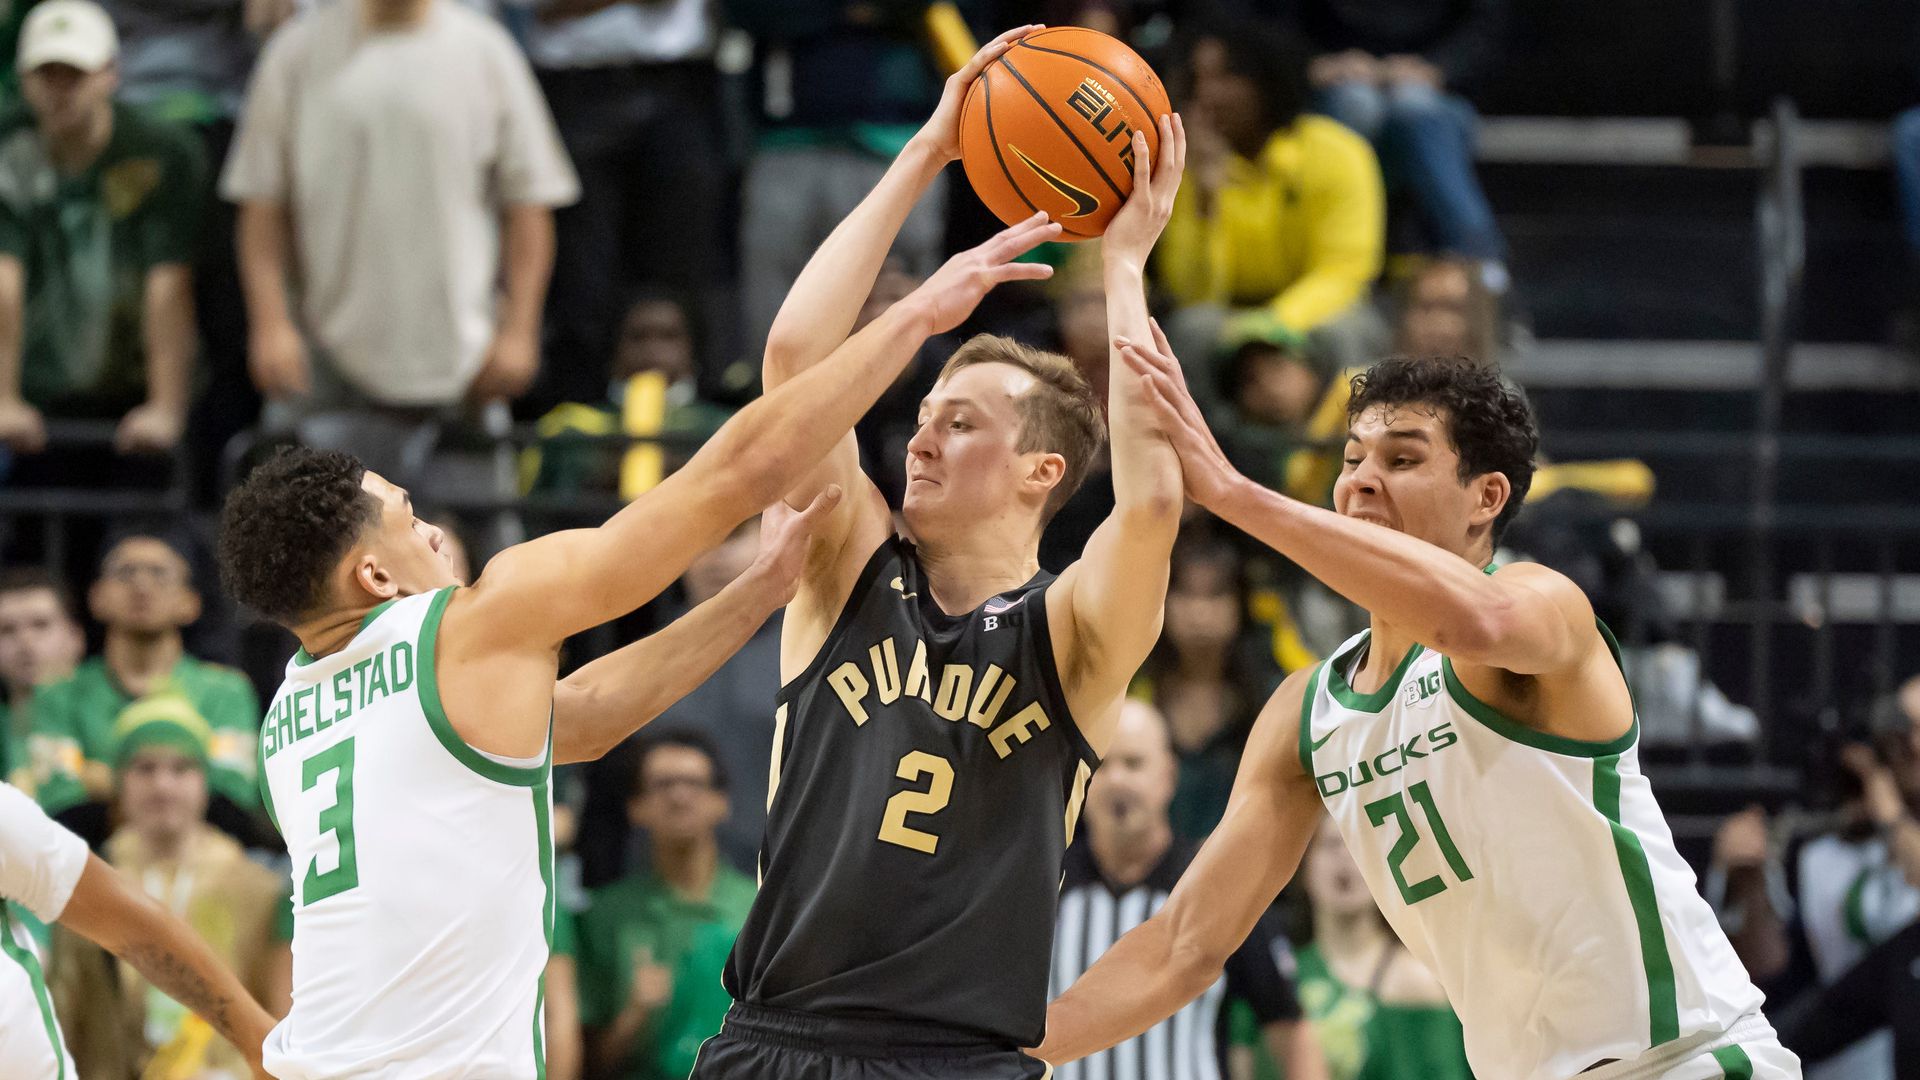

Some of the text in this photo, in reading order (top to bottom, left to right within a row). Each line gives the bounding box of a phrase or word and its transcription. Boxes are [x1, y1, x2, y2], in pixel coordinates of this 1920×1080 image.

[265, 641, 413, 760] SHELSTAD
[827, 637, 1051, 760] PURDUE
[878, 750, 955, 855] 2
[1316, 722, 1457, 798] DUCKS
[302, 736, 359, 907] 3
[1364, 779, 1474, 906] 21
